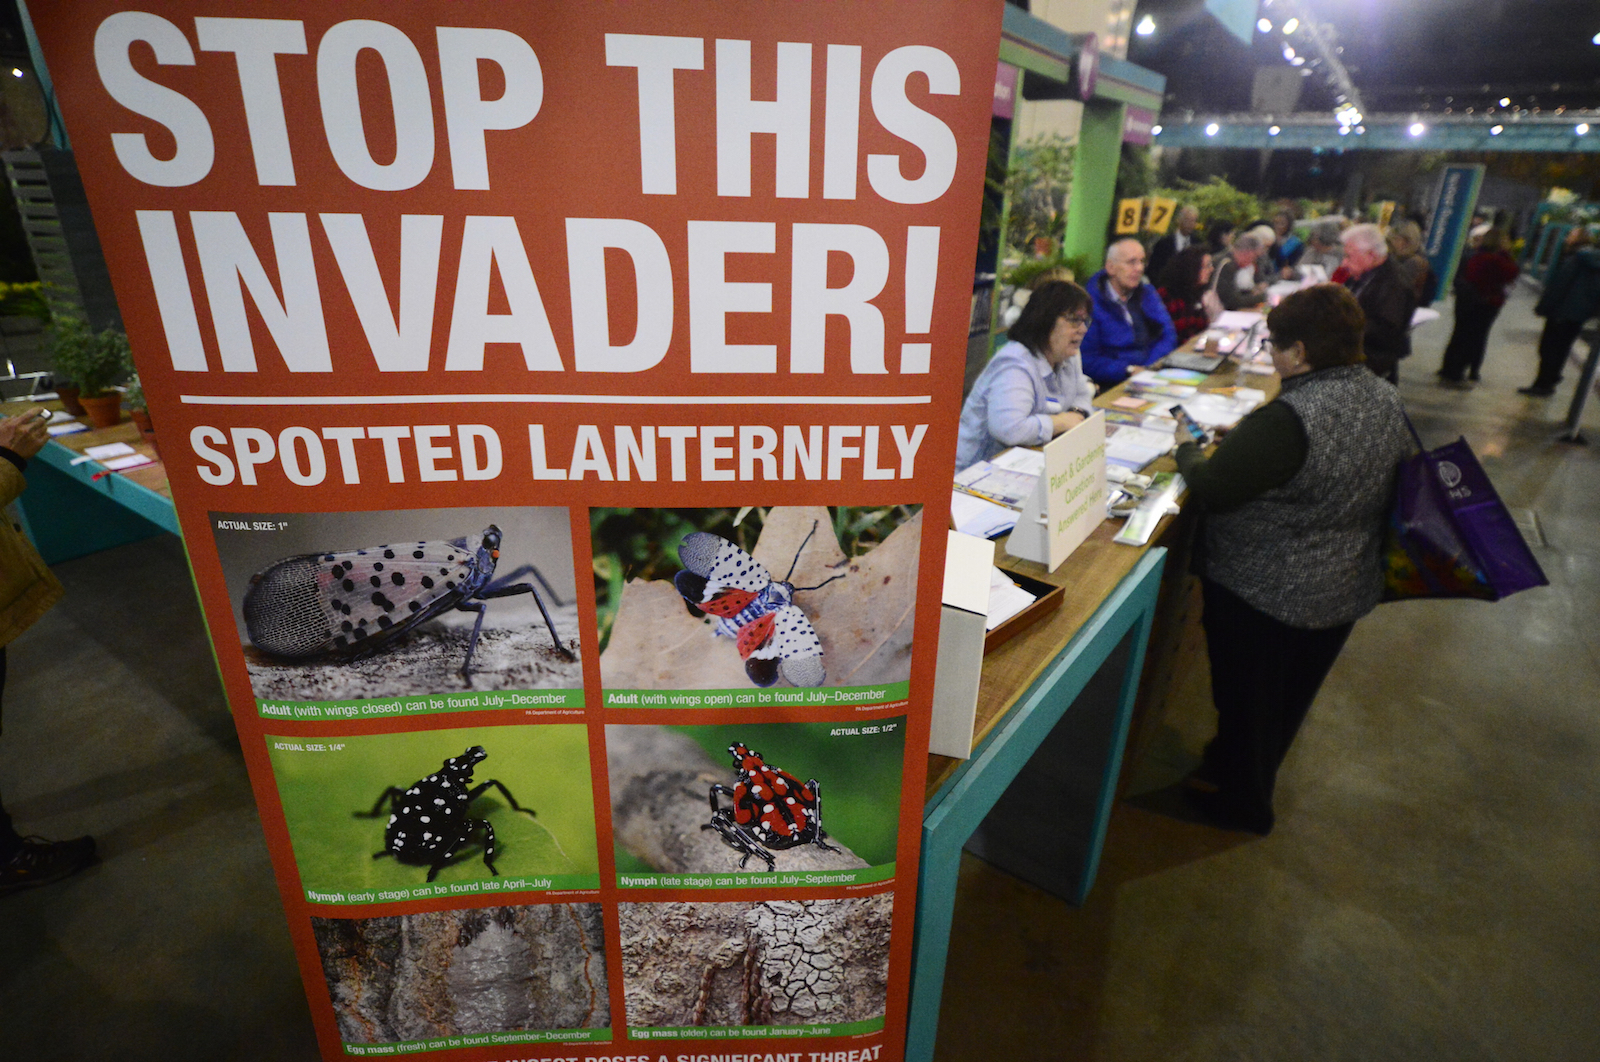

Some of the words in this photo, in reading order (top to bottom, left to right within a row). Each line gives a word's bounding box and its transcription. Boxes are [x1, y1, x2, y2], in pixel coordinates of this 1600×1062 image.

[93, 10, 544, 192] STOP
[604, 32, 961, 204] THIS
[135, 209, 941, 375] INVADER!
[189, 424, 503, 487] SPOTTED
[528, 424, 929, 482] LANTERNFLY
[1050, 469, 1068, 494] Plant
[1069, 462, 1075, 479] &
[1066, 472, 1096, 504] Questions
[1058, 494, 1089, 536] Answered
[1089, 488, 1102, 507] Here
[217, 520, 252, 530] ACTUAL
[252, 521, 276, 531] SIZE:
[262, 703, 292, 716] Adult
[294, 705, 322, 718] (with
[324, 704, 359, 717] wings
[361, 702, 403, 714] closed)
[405, 701, 427, 711] can
[430, 699, 444, 709] be
[447, 696, 479, 708] found
[607, 693, 638, 704] Adult
[641, 694, 667, 706] (with
[669, 694, 701, 706] wings
[703, 693, 733, 706] open)
[735, 694, 755, 704] can
[758, 692, 771, 702] be
[774, 692, 804, 703] found
[830, 727, 860, 736] ACTUAL
[861, 726, 880, 735] SIZE:
[274, 742, 305, 751] ACTUAL
[305, 743, 327, 752] SIZE:
[307, 890, 345, 903] Nymph
[347, 892, 375, 903] (early
[378, 889, 410, 900] stage)
[412, 887, 432, 896] can
[434, 885, 447, 894] be
[450, 881, 479, 893] found
[481, 881, 500, 891] late
[621, 876, 658, 887] Nymph
[660, 876, 681, 887] (late
[683, 877, 713, 888] stage)
[715, 877, 733, 886] can
[735, 876, 748, 885] be
[750, 875, 777, 885] found
[631, 1029, 650, 1039] Egg
[680, 1029, 708, 1038] (older)
[710, 1029, 726, 1037] can
[728, 1028, 740, 1036] be
[742, 1028, 767, 1036] found
[346, 1044, 366, 1055] Egg
[367, 1045, 395, 1054] mass
[397, 1042, 427, 1053] (fresh)
[429, 1039, 447, 1048] can
[448, 1037, 460, 1046] be
[463, 1035, 489, 1045] found
[808, 1044, 883, 1062] THREAT
